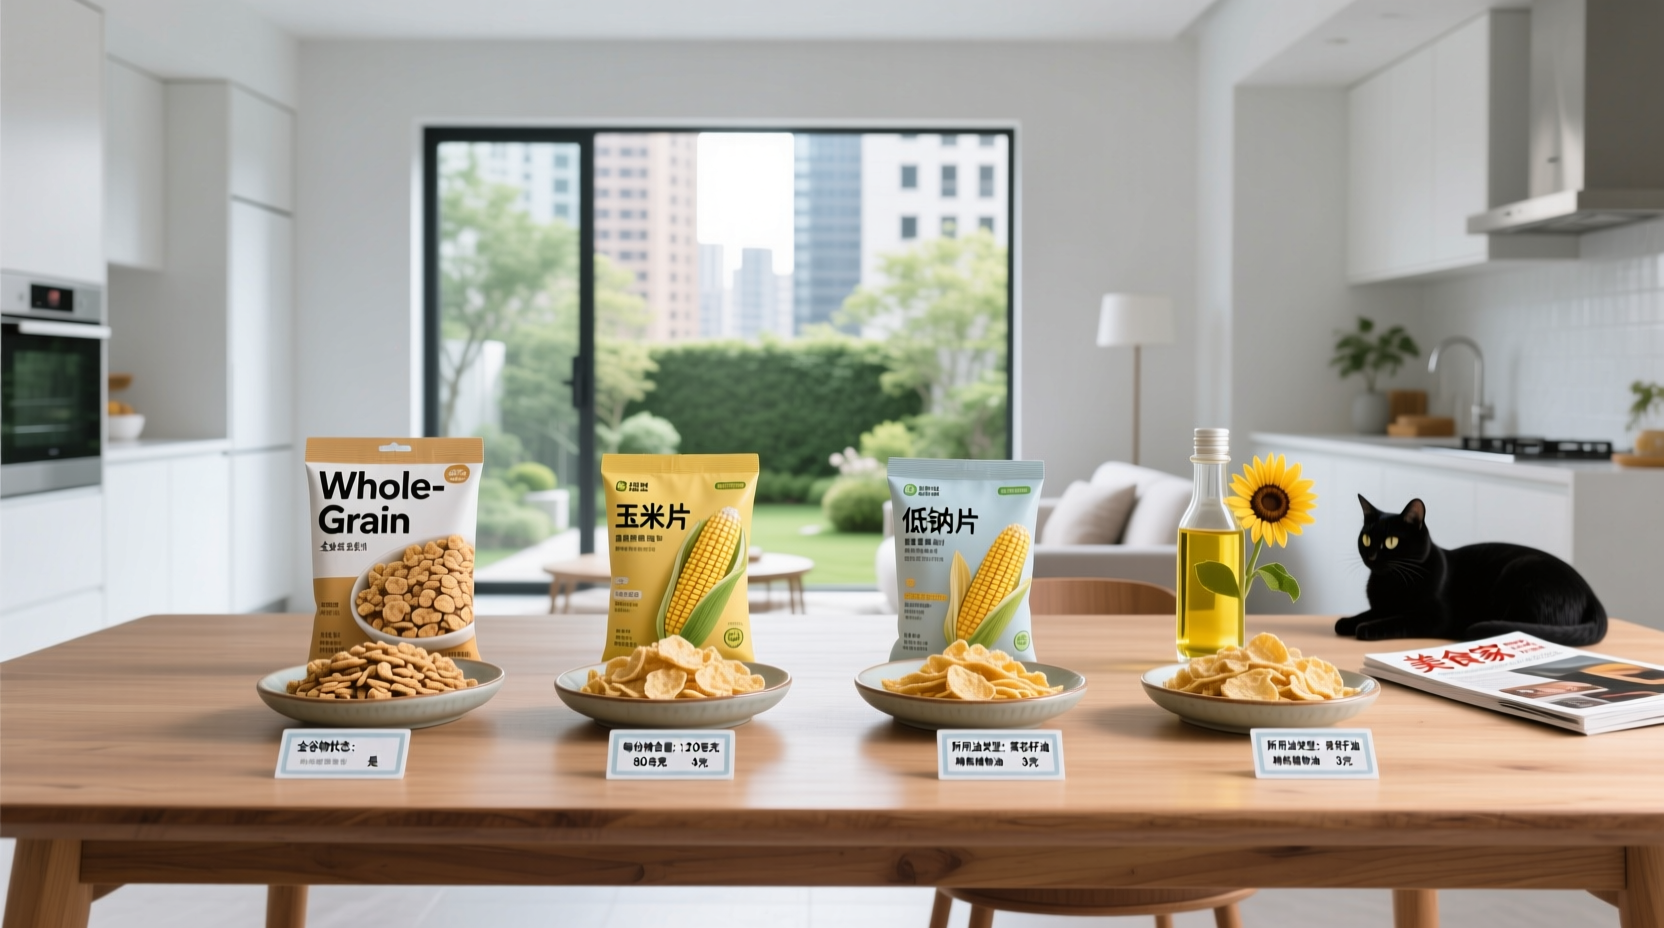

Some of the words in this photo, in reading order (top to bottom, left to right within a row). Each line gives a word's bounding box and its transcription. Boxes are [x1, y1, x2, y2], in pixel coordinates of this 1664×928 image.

[319, 470, 445, 500] Whole-
[318, 504, 410, 534] Grain
[615, 503, 691, 530] 玉米片
[902, 506, 979, 535] 低钠片
[1403, 643, 1515, 673] 美食家
